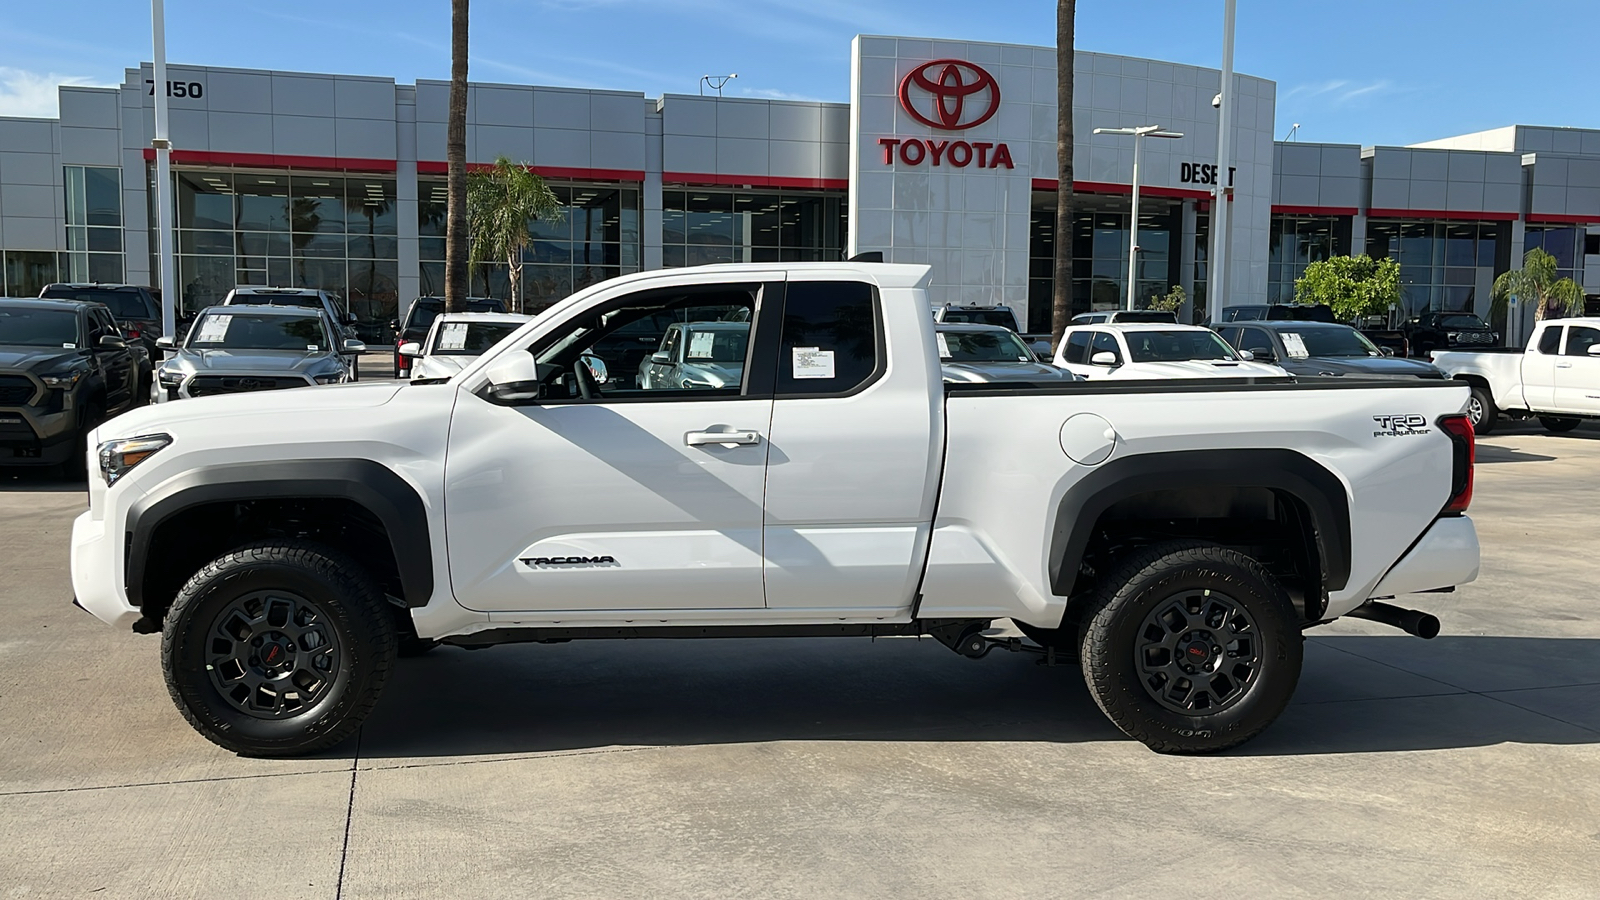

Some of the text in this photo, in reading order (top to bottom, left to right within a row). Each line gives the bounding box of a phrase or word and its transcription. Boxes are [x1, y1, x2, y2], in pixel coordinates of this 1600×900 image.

[878, 138, 1015, 169] TOYOTA
[1180, 162, 1236, 187] DESET
[1373, 414, 1427, 431] TRD
[519, 556, 615, 566] TACOMA
